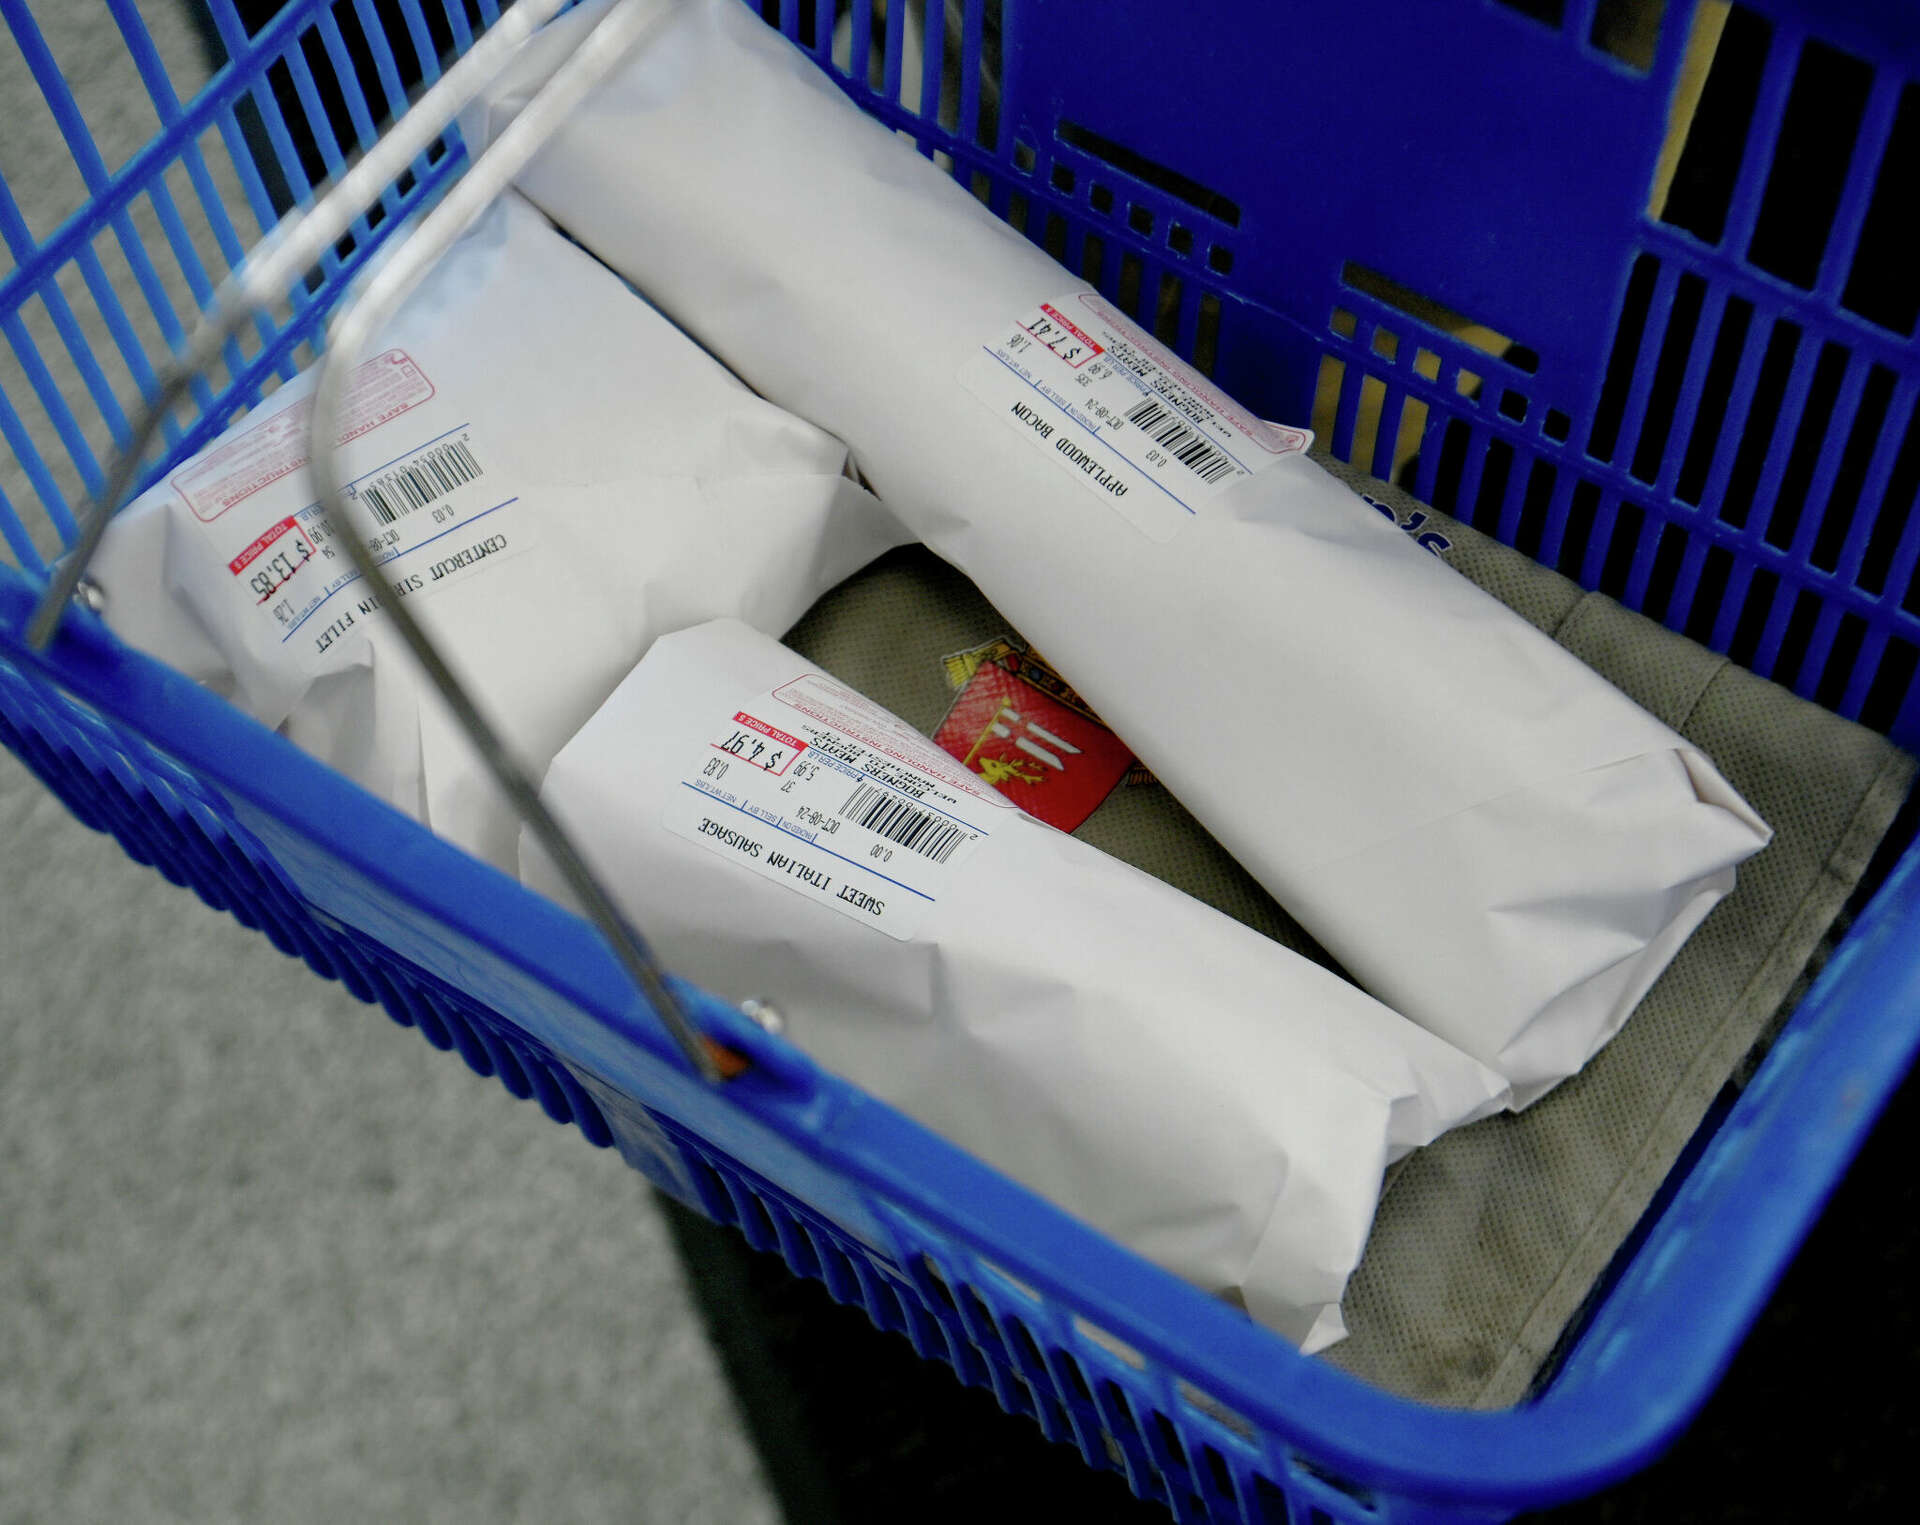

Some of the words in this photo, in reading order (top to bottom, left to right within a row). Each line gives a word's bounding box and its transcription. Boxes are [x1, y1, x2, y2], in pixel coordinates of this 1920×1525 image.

[1026, 317, 1068, 350] 7.41
[1149, 379, 1203, 423] BOGNERS
[1008, 401, 1055, 437] BACON
[1053, 436, 1130, 497] APPLEWOOD
[430, 503, 455, 523] 0.03
[261, 521, 288, 544] TOTAL
[425, 532, 508, 581] CENTERCUT
[248, 551, 297, 602] 13.85
[356, 573, 424, 615] SIRIN
[312, 611, 355, 653] FILET
[744, 717, 771, 734] PRICE
[769, 729, 797, 746] TOTAL
[720, 728, 767, 763] 4.97
[808, 736, 857, 764] MEATS
[701, 756, 730, 780] 0.83
[792, 759, 820, 781] 5.99
[860, 762, 924, 798] BOGNERS
[720, 791, 737, 802] NET
[779, 778, 796, 792] 37
[757, 809, 777, 822] SELL
[794, 804, 842, 834] OCT-08-24
[694, 816, 764, 857] SAUSAGE
[867, 843, 894, 862] 0.00
[764, 850, 833, 889] ITALIAN
[835, 884, 887, 915] SWEET
